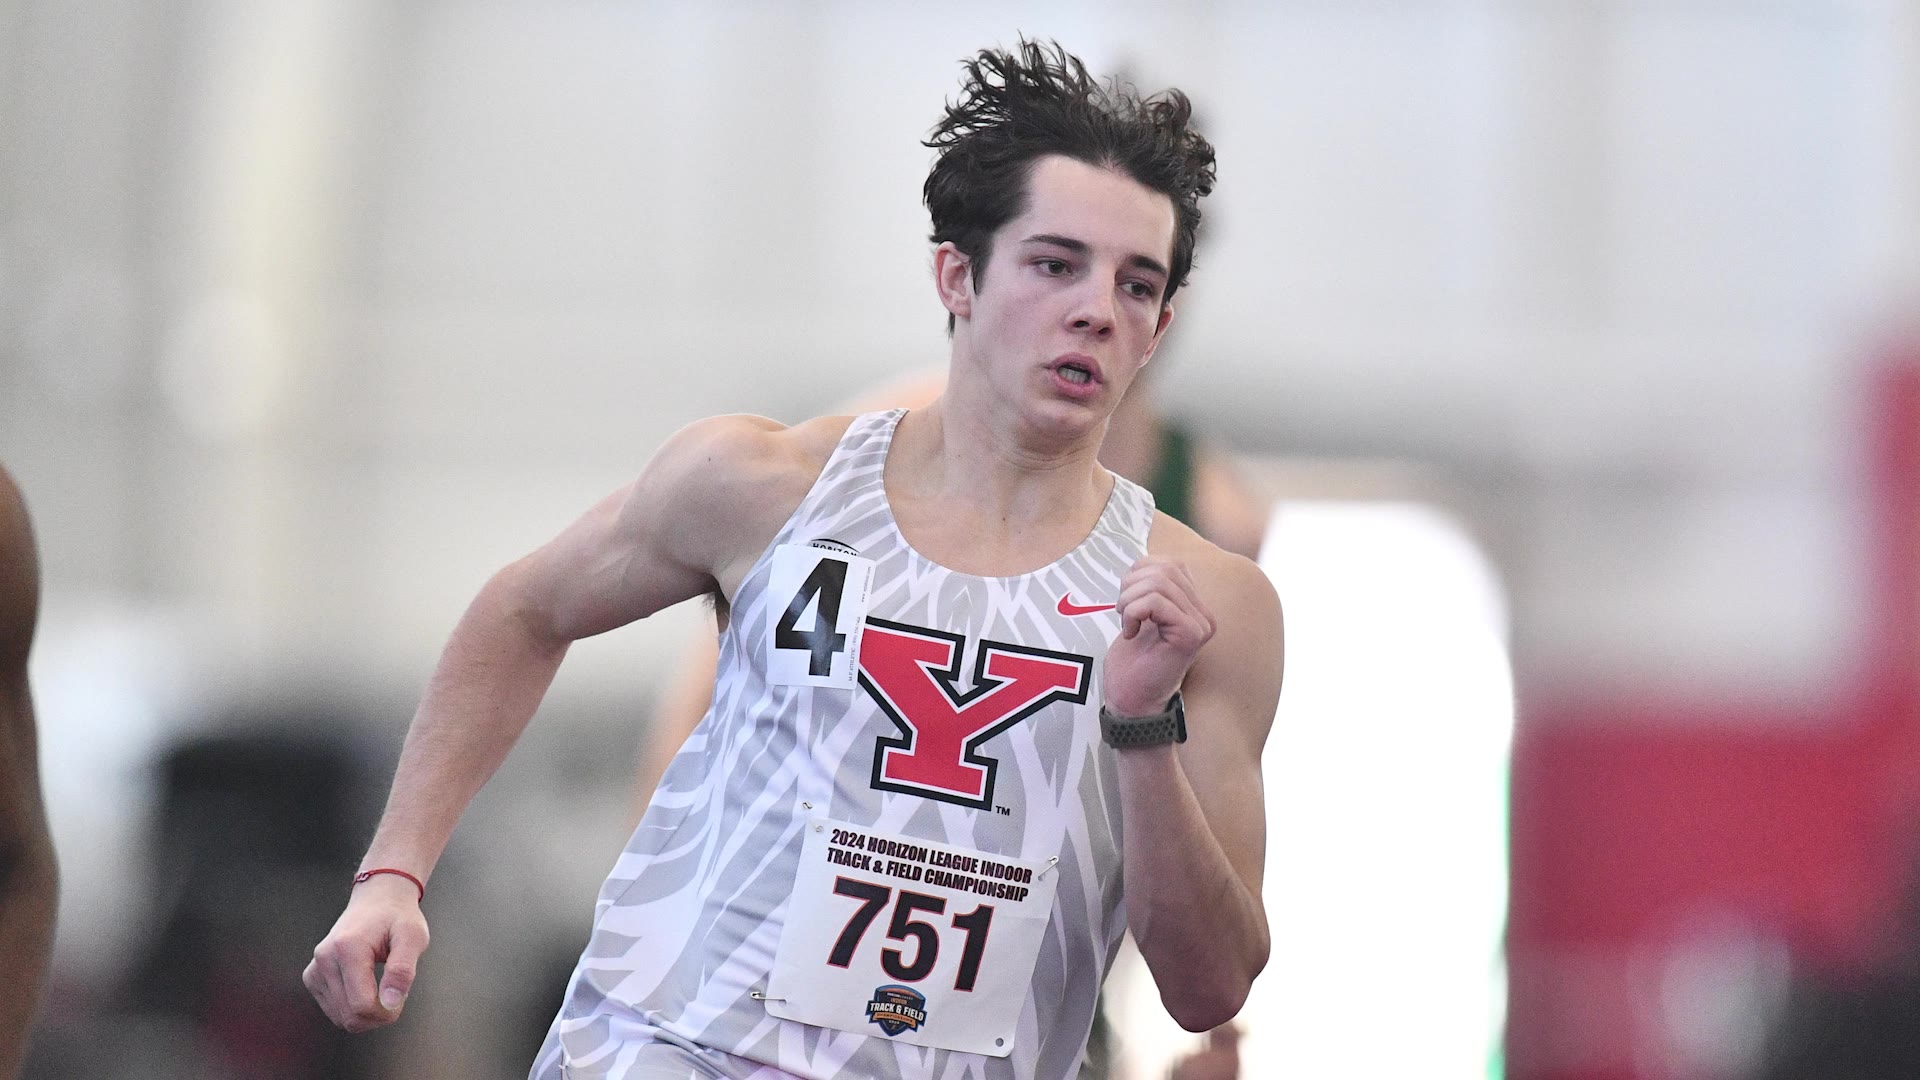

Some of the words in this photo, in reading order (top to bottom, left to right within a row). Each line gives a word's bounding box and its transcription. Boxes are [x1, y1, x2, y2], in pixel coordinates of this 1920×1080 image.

[775, 557, 849, 677] 4
[857, 615, 1094, 812] Y
[995, 805, 1010, 816] TM
[827, 847, 871, 871] TRACK
[872, 860, 884, 874] &
[885, 861, 923, 882] FIELD
[924, 869, 1029, 902] CHAMPIONSHIP
[830, 828, 865, 850] 2024
[867, 836, 928, 863] HORIZON
[929, 849, 978, 874] LEAGUE
[980, 860, 1033, 884] INDOOR
[826, 875, 995, 992] 751
[870, 1002, 896, 1012] TRACK
[896, 1004, 902, 1014] &
[903, 1006, 924, 1021] FIELD
